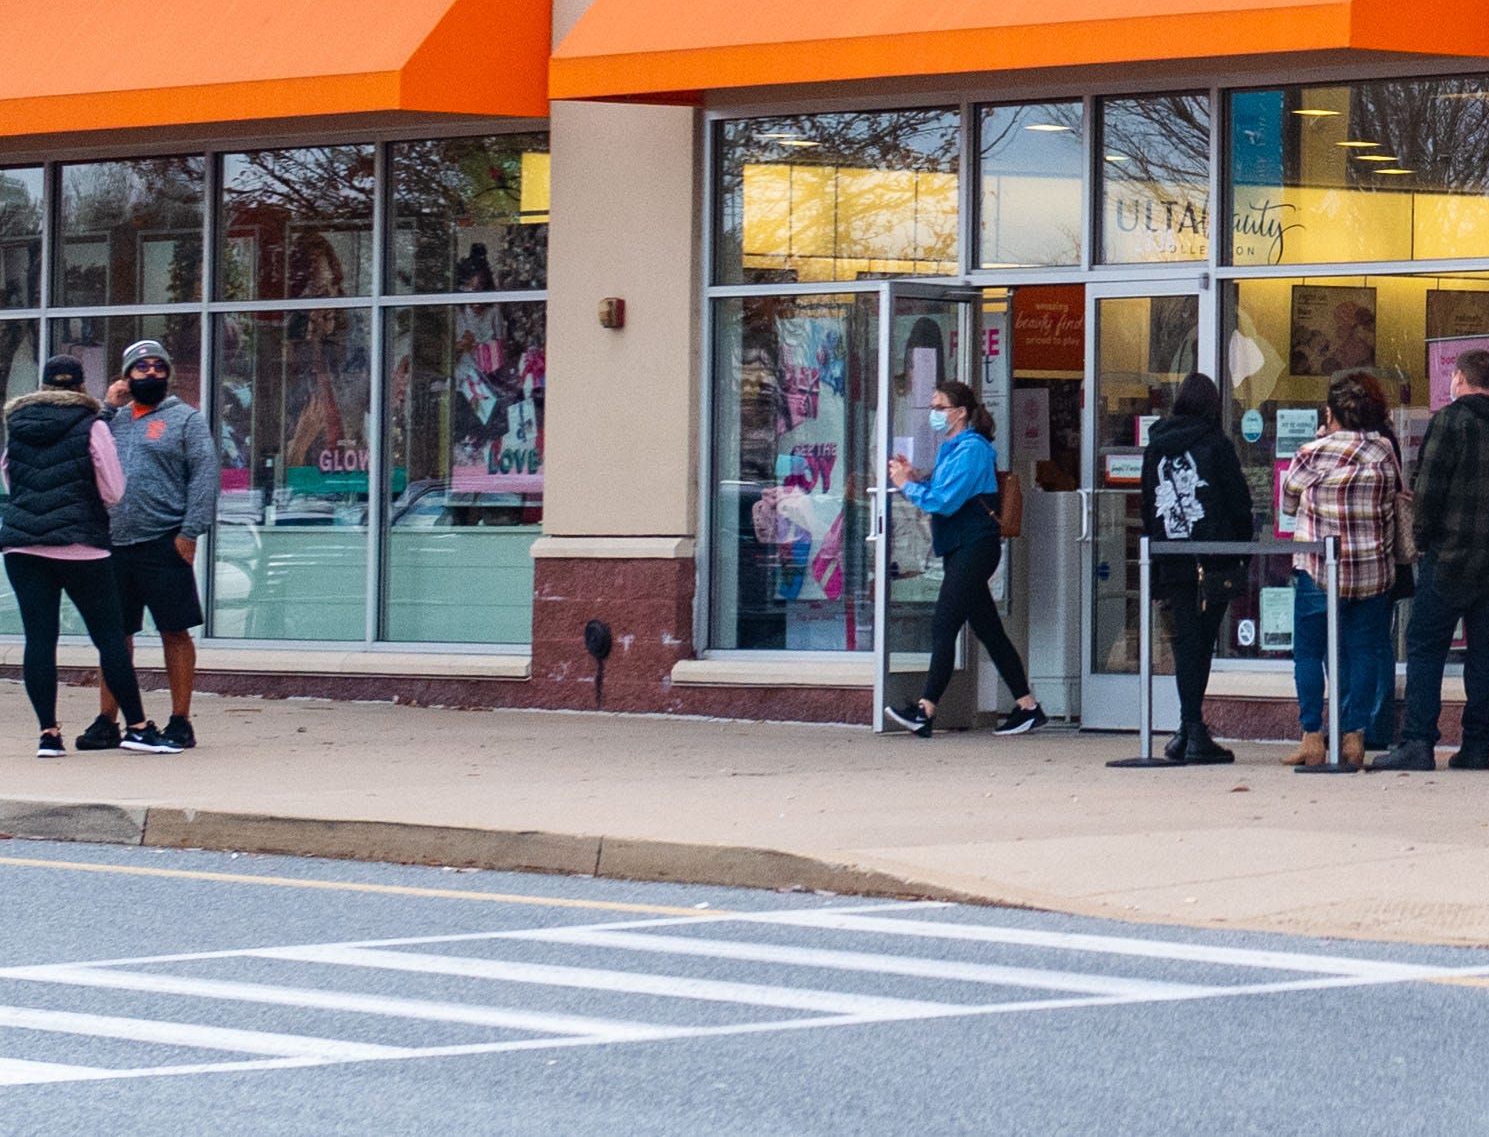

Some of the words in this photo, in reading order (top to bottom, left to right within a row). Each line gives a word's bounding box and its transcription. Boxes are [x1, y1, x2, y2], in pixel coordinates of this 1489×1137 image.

[1116, 199, 1200, 234] ULTA
[488, 448, 539, 475] LOVE
[817, 442, 837, 456] THE
